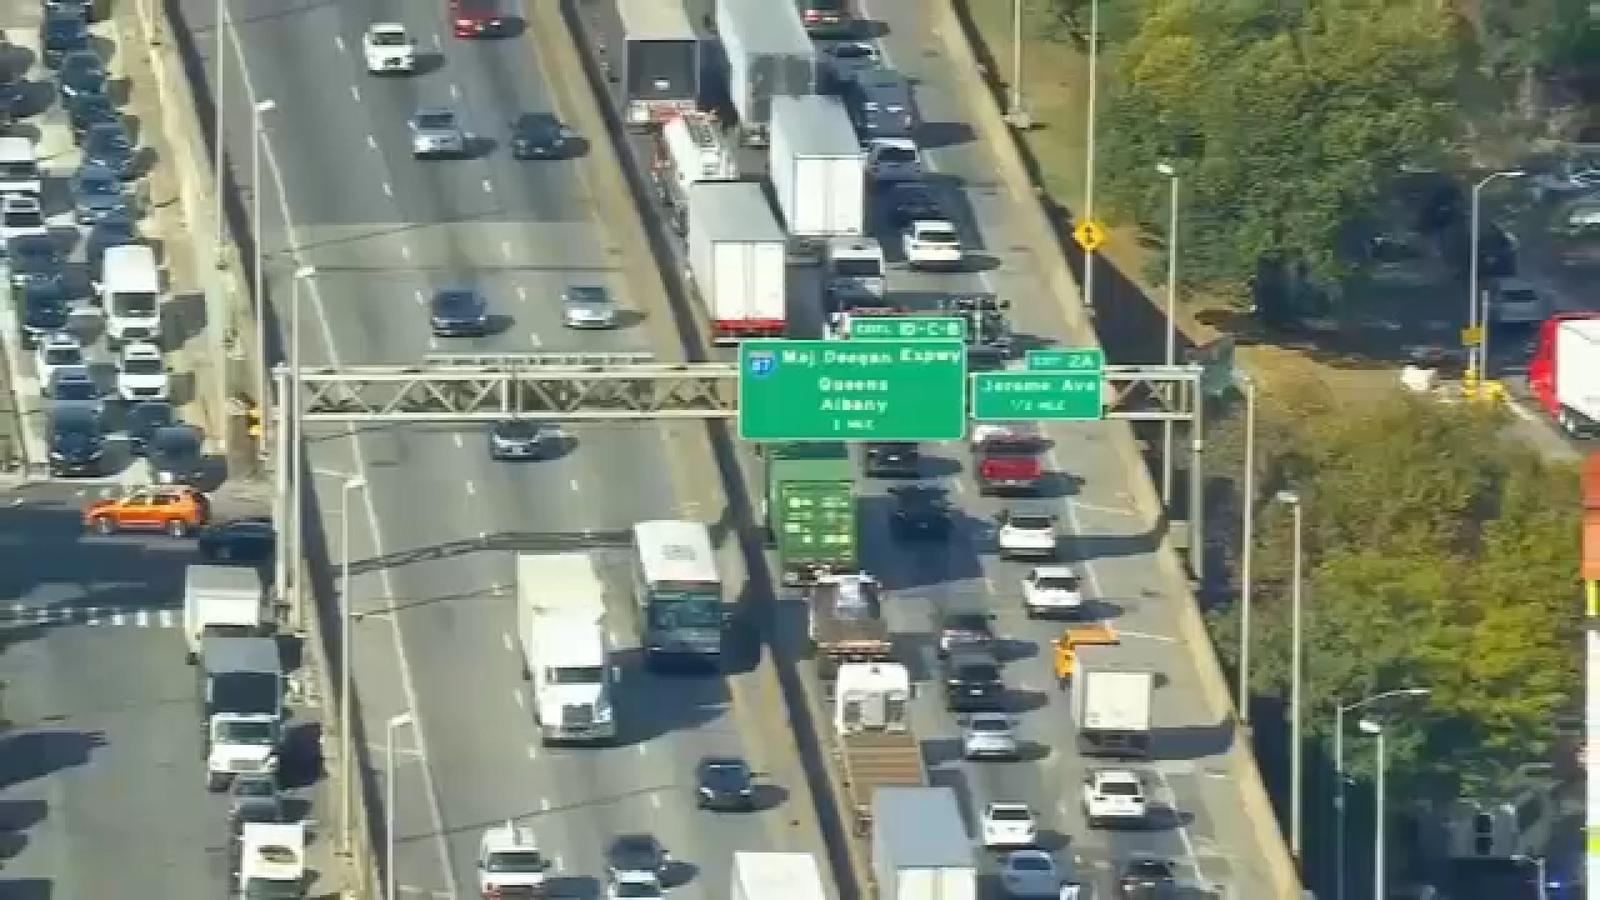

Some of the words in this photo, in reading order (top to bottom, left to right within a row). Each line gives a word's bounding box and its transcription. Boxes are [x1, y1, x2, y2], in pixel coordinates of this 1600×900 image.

[782, 349, 816, 367] Maj
[823, 349, 893, 367] Deegan
[899, 347, 962, 365] Expwy
[1067, 354, 1094, 368] 2A
[817, 376, 889, 392] Queens
[981, 379, 1051, 392] Jerome
[1062, 379, 1096, 391] Ave
[819, 397, 889, 413] Albany
